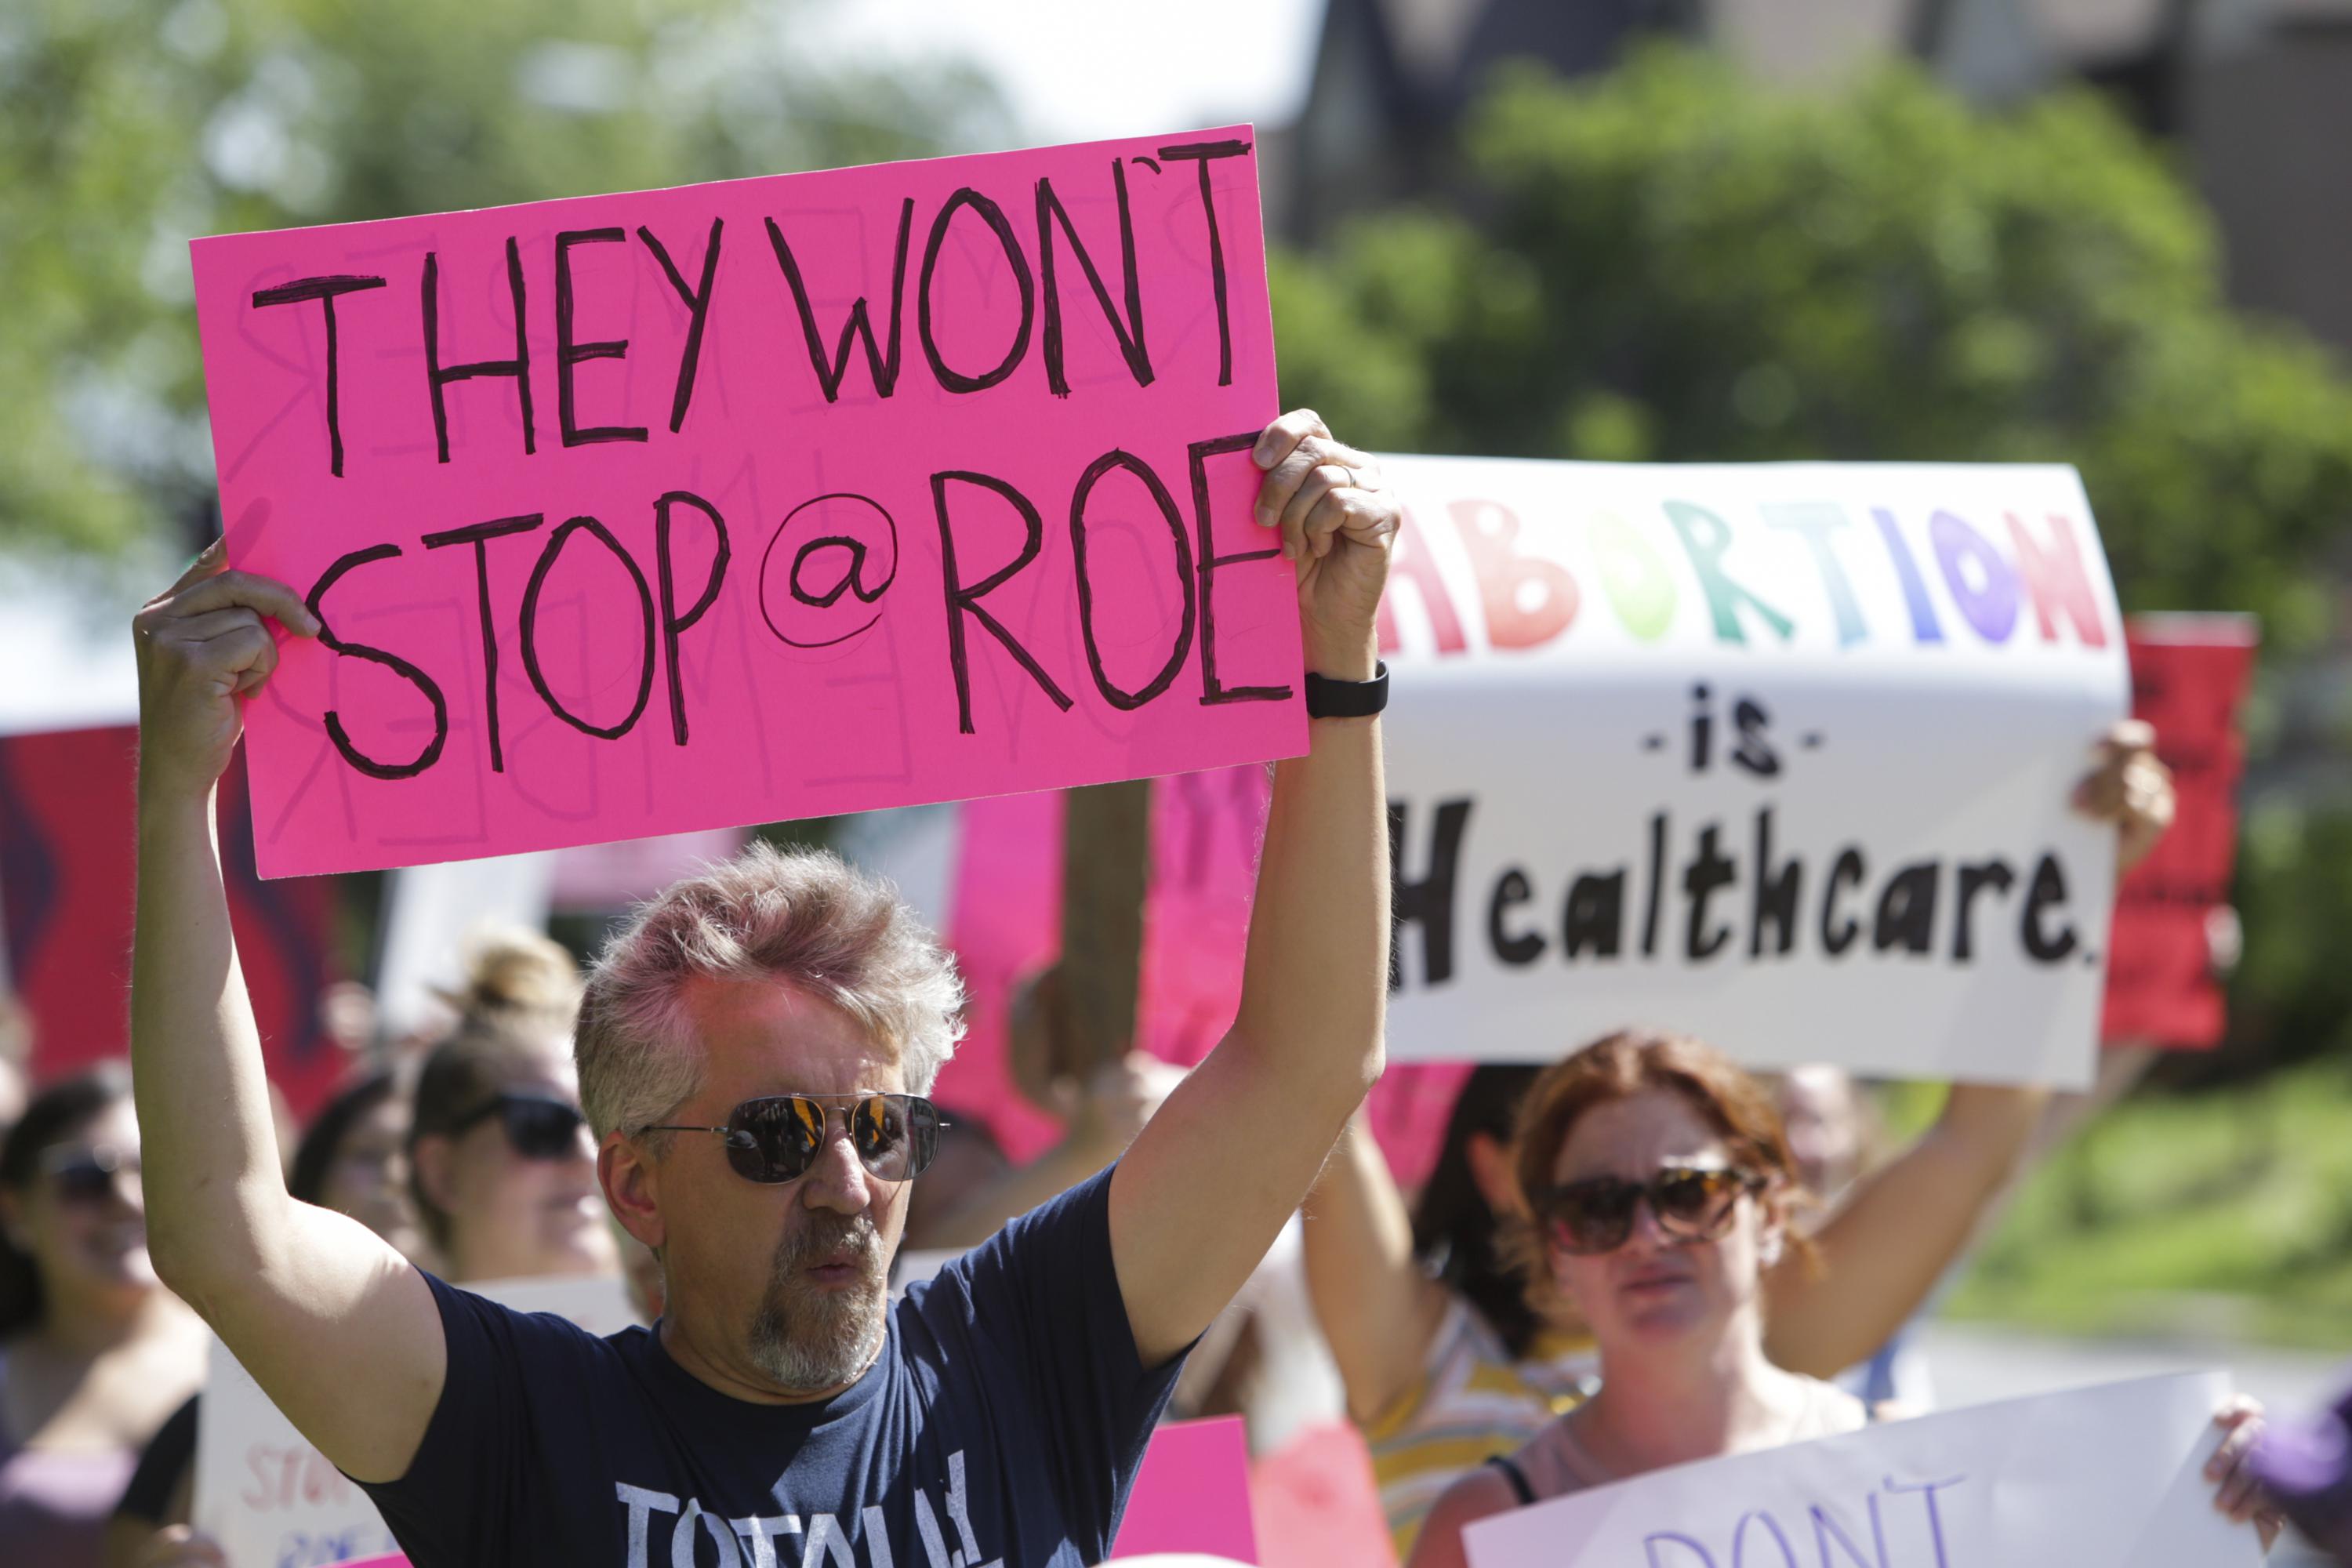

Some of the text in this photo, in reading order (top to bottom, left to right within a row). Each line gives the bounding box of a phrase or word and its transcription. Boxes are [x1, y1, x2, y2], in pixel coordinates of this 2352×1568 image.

[252, 139, 1252, 478] THEY WON'T
[305, 430, 1294, 780] STOP @ ROE
[1377, 499, 2108, 655] ABORTION
[1388, 796, 2099, 993] Healthcare.
